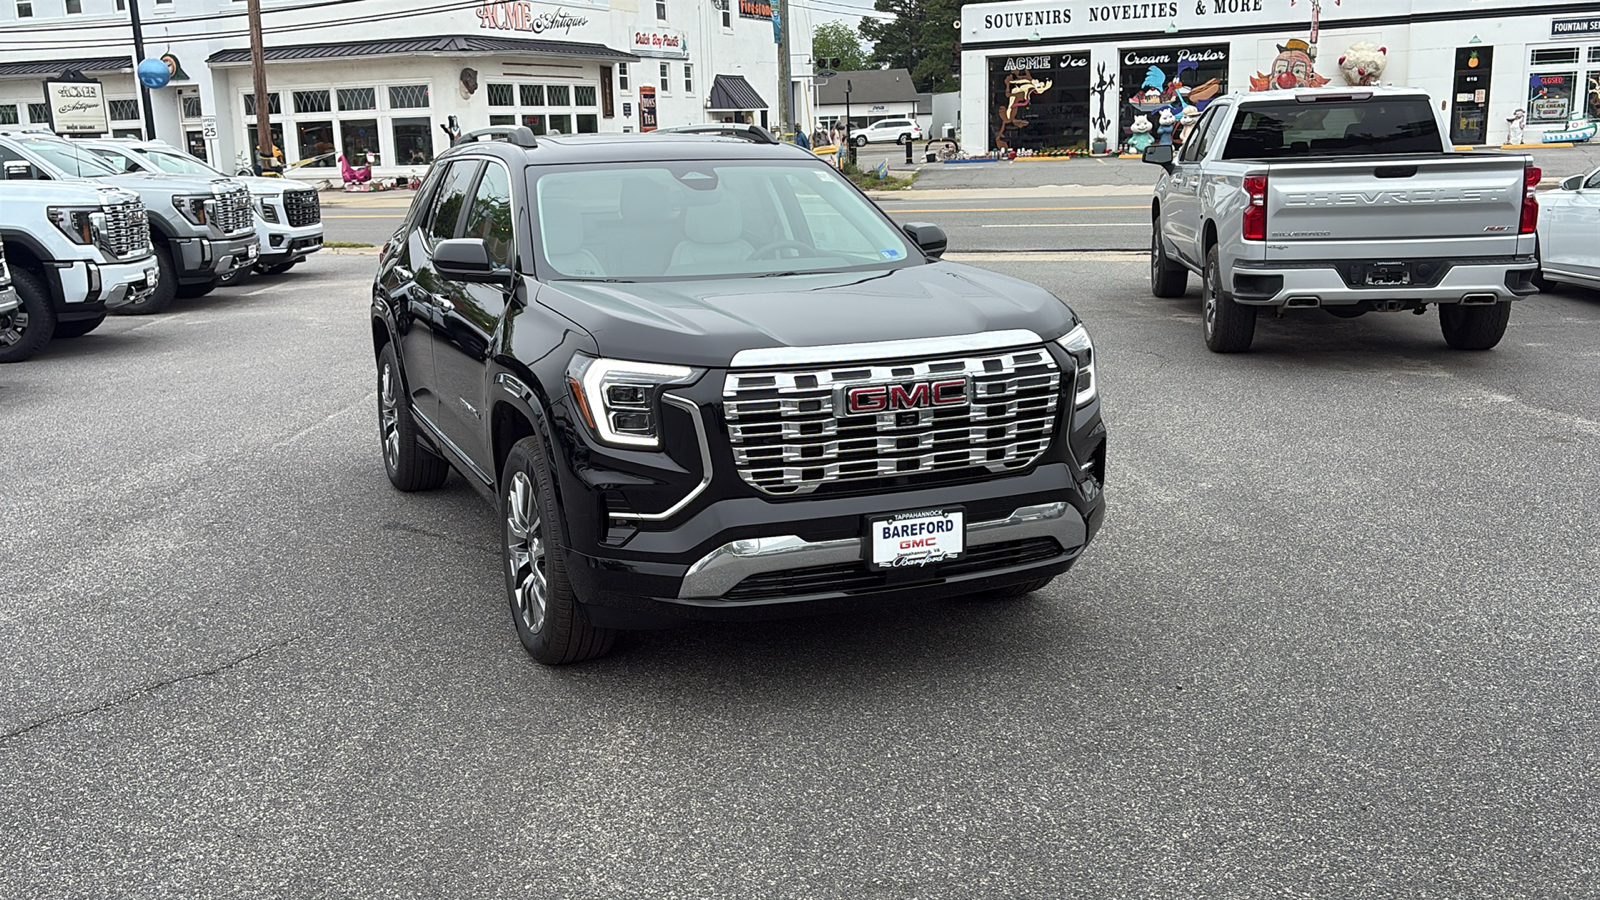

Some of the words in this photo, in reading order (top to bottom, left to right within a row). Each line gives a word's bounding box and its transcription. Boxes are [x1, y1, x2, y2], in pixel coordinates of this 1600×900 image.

[740, 0, 773, 16] Fireston
[985, 9, 1071, 29] SOUVENIRS
[1089, 2, 1178, 22] NOVELTIES
[1195, 0, 1206, 15] &
[1214, 0, 1263, 14] MORE
[476, 0, 532, 32] ACME
[533, 7, 588, 35] Antiques
[1554, 21, 1588, 32] FOUNTAIN
[635, 31, 650, 45] Dutch
[652, 33, 662, 48] Boy
[663, 34, 679, 47] Paints
[1004, 55, 1051, 71] ACME
[1060, 54, 1088, 68] Ice
[1124, 51, 1170, 65] Cream
[1177, 49, 1226, 63] Parlor
[58, 86, 97, 97] ACME
[59, 101, 100, 113] Antiques
[643, 112, 656, 124] TEA
[204, 128, 217, 137] 25
[1286, 188, 1507, 206] CHEVROLET
[1483, 224, 1515, 232] RST
[849, 379, 968, 412] GMC
[894, 509, 943, 520] TAPPAHANNOCK
[882, 519, 954, 539] BAREFORD
[899, 537, 937, 549] GMC
[892, 551, 946, 568] Bareford
